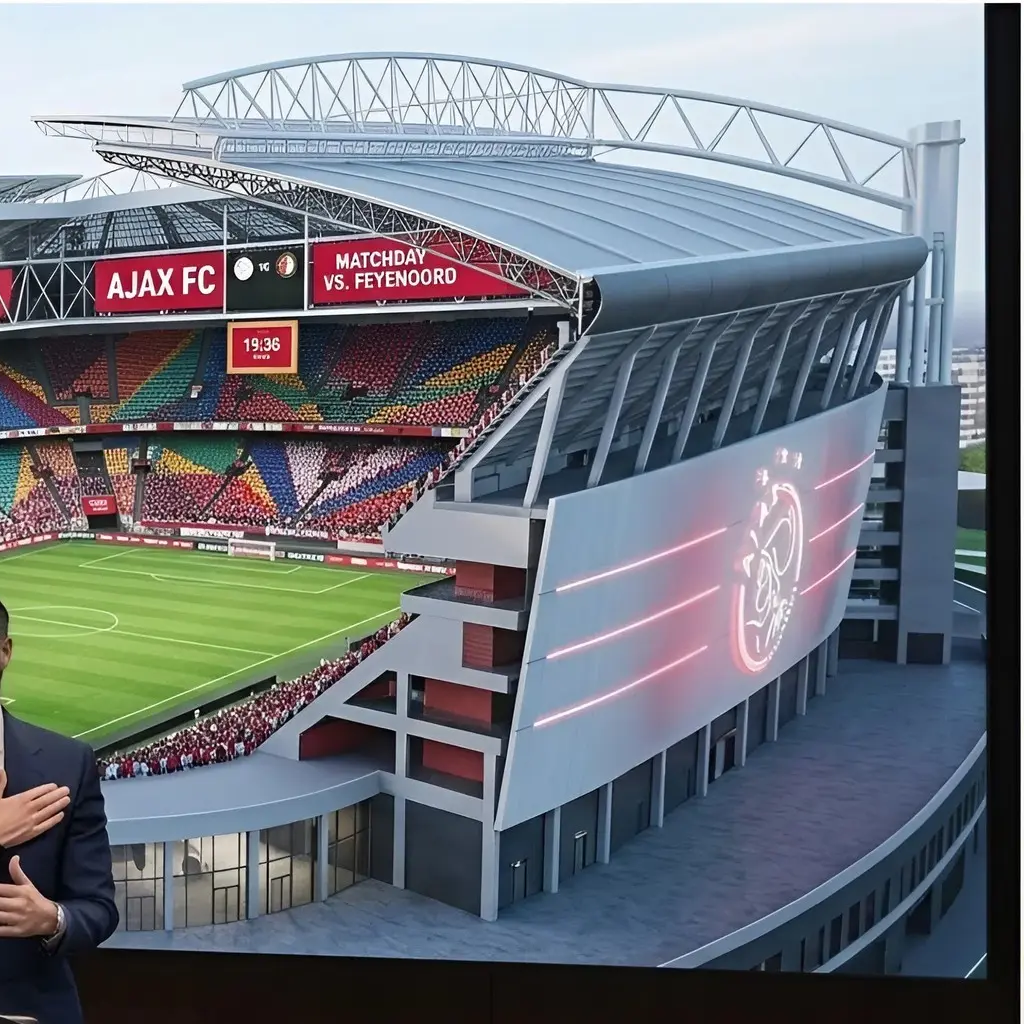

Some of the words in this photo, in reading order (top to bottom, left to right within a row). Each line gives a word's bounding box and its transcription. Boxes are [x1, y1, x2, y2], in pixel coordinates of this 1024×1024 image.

[335, 248, 427, 270] MATCHDAY
[107, 267, 175, 299] AJAX
[182, 265, 216, 295] FC
[323, 274, 349, 291] VS.
[354, 267, 457, 289] FEYENOORD
